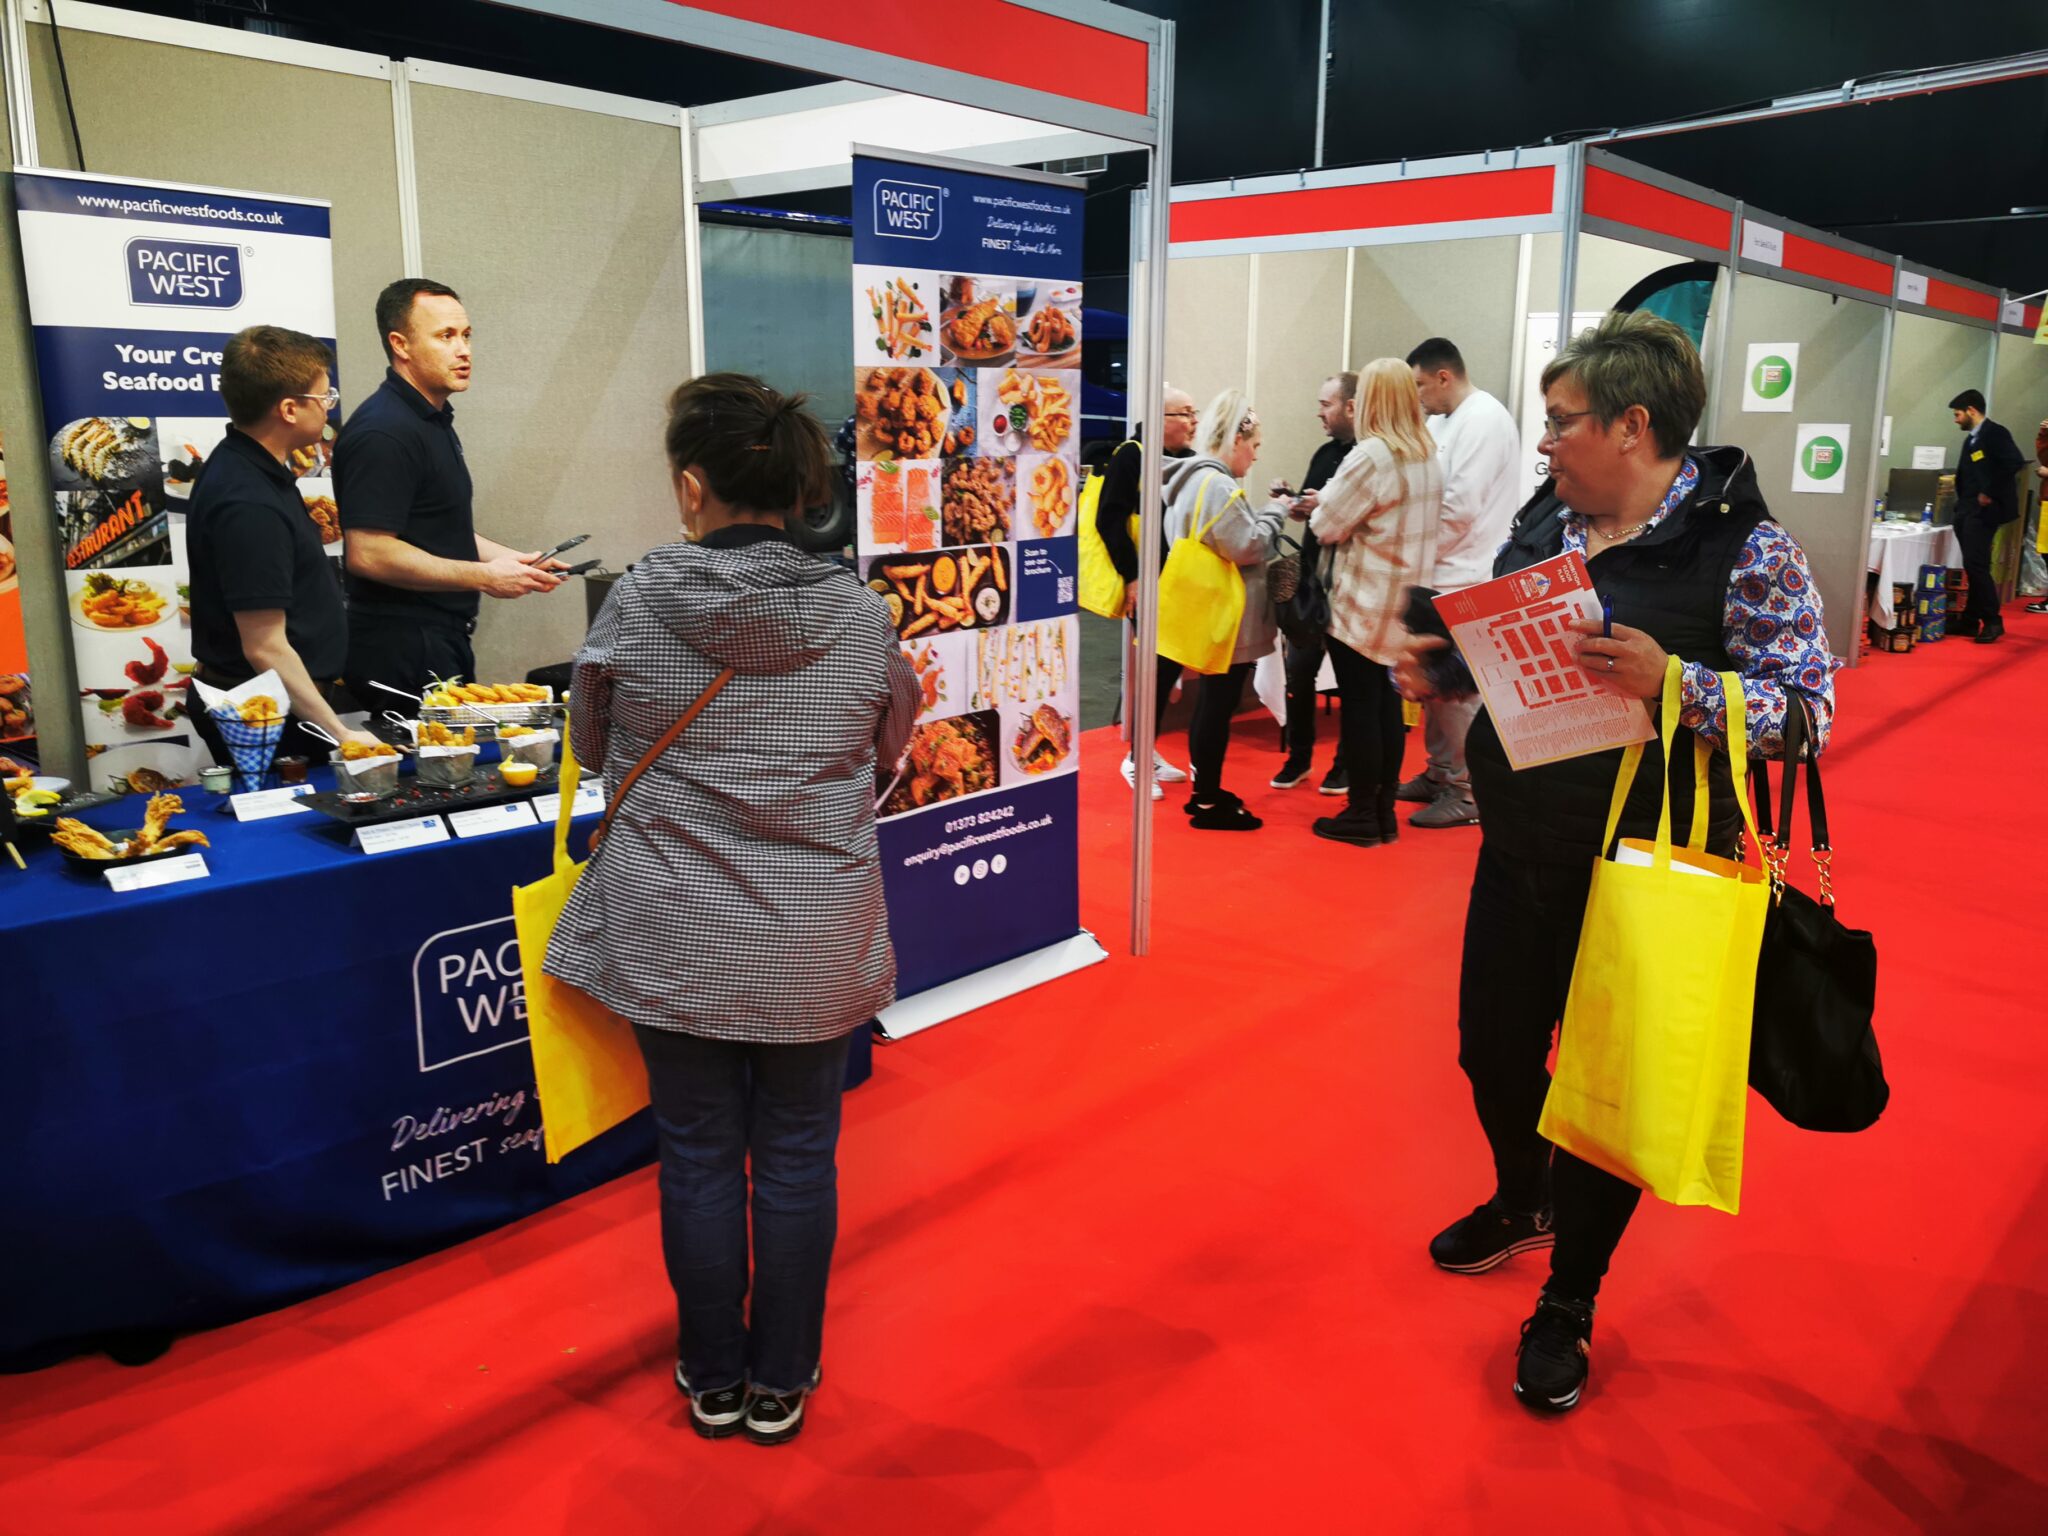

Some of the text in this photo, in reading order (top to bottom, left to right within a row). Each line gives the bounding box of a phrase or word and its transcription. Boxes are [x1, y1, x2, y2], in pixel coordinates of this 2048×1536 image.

[77, 194, 284, 225] www.pacificwestfoods.co.uk
[881, 188, 935, 212] PACIFIC
[887, 208, 931, 231] WEST
[982, 237, 1012, 250] FINEST
[138, 248, 232, 276] PACIFIC
[148, 272, 225, 299] WEST
[115, 344, 176, 365] Your
[103, 372, 204, 391] Seafood
[945, 815, 976, 833] 01373
[391, 1091, 526, 1152] Delivering
[382, 1137, 489, 1201] FINEST
